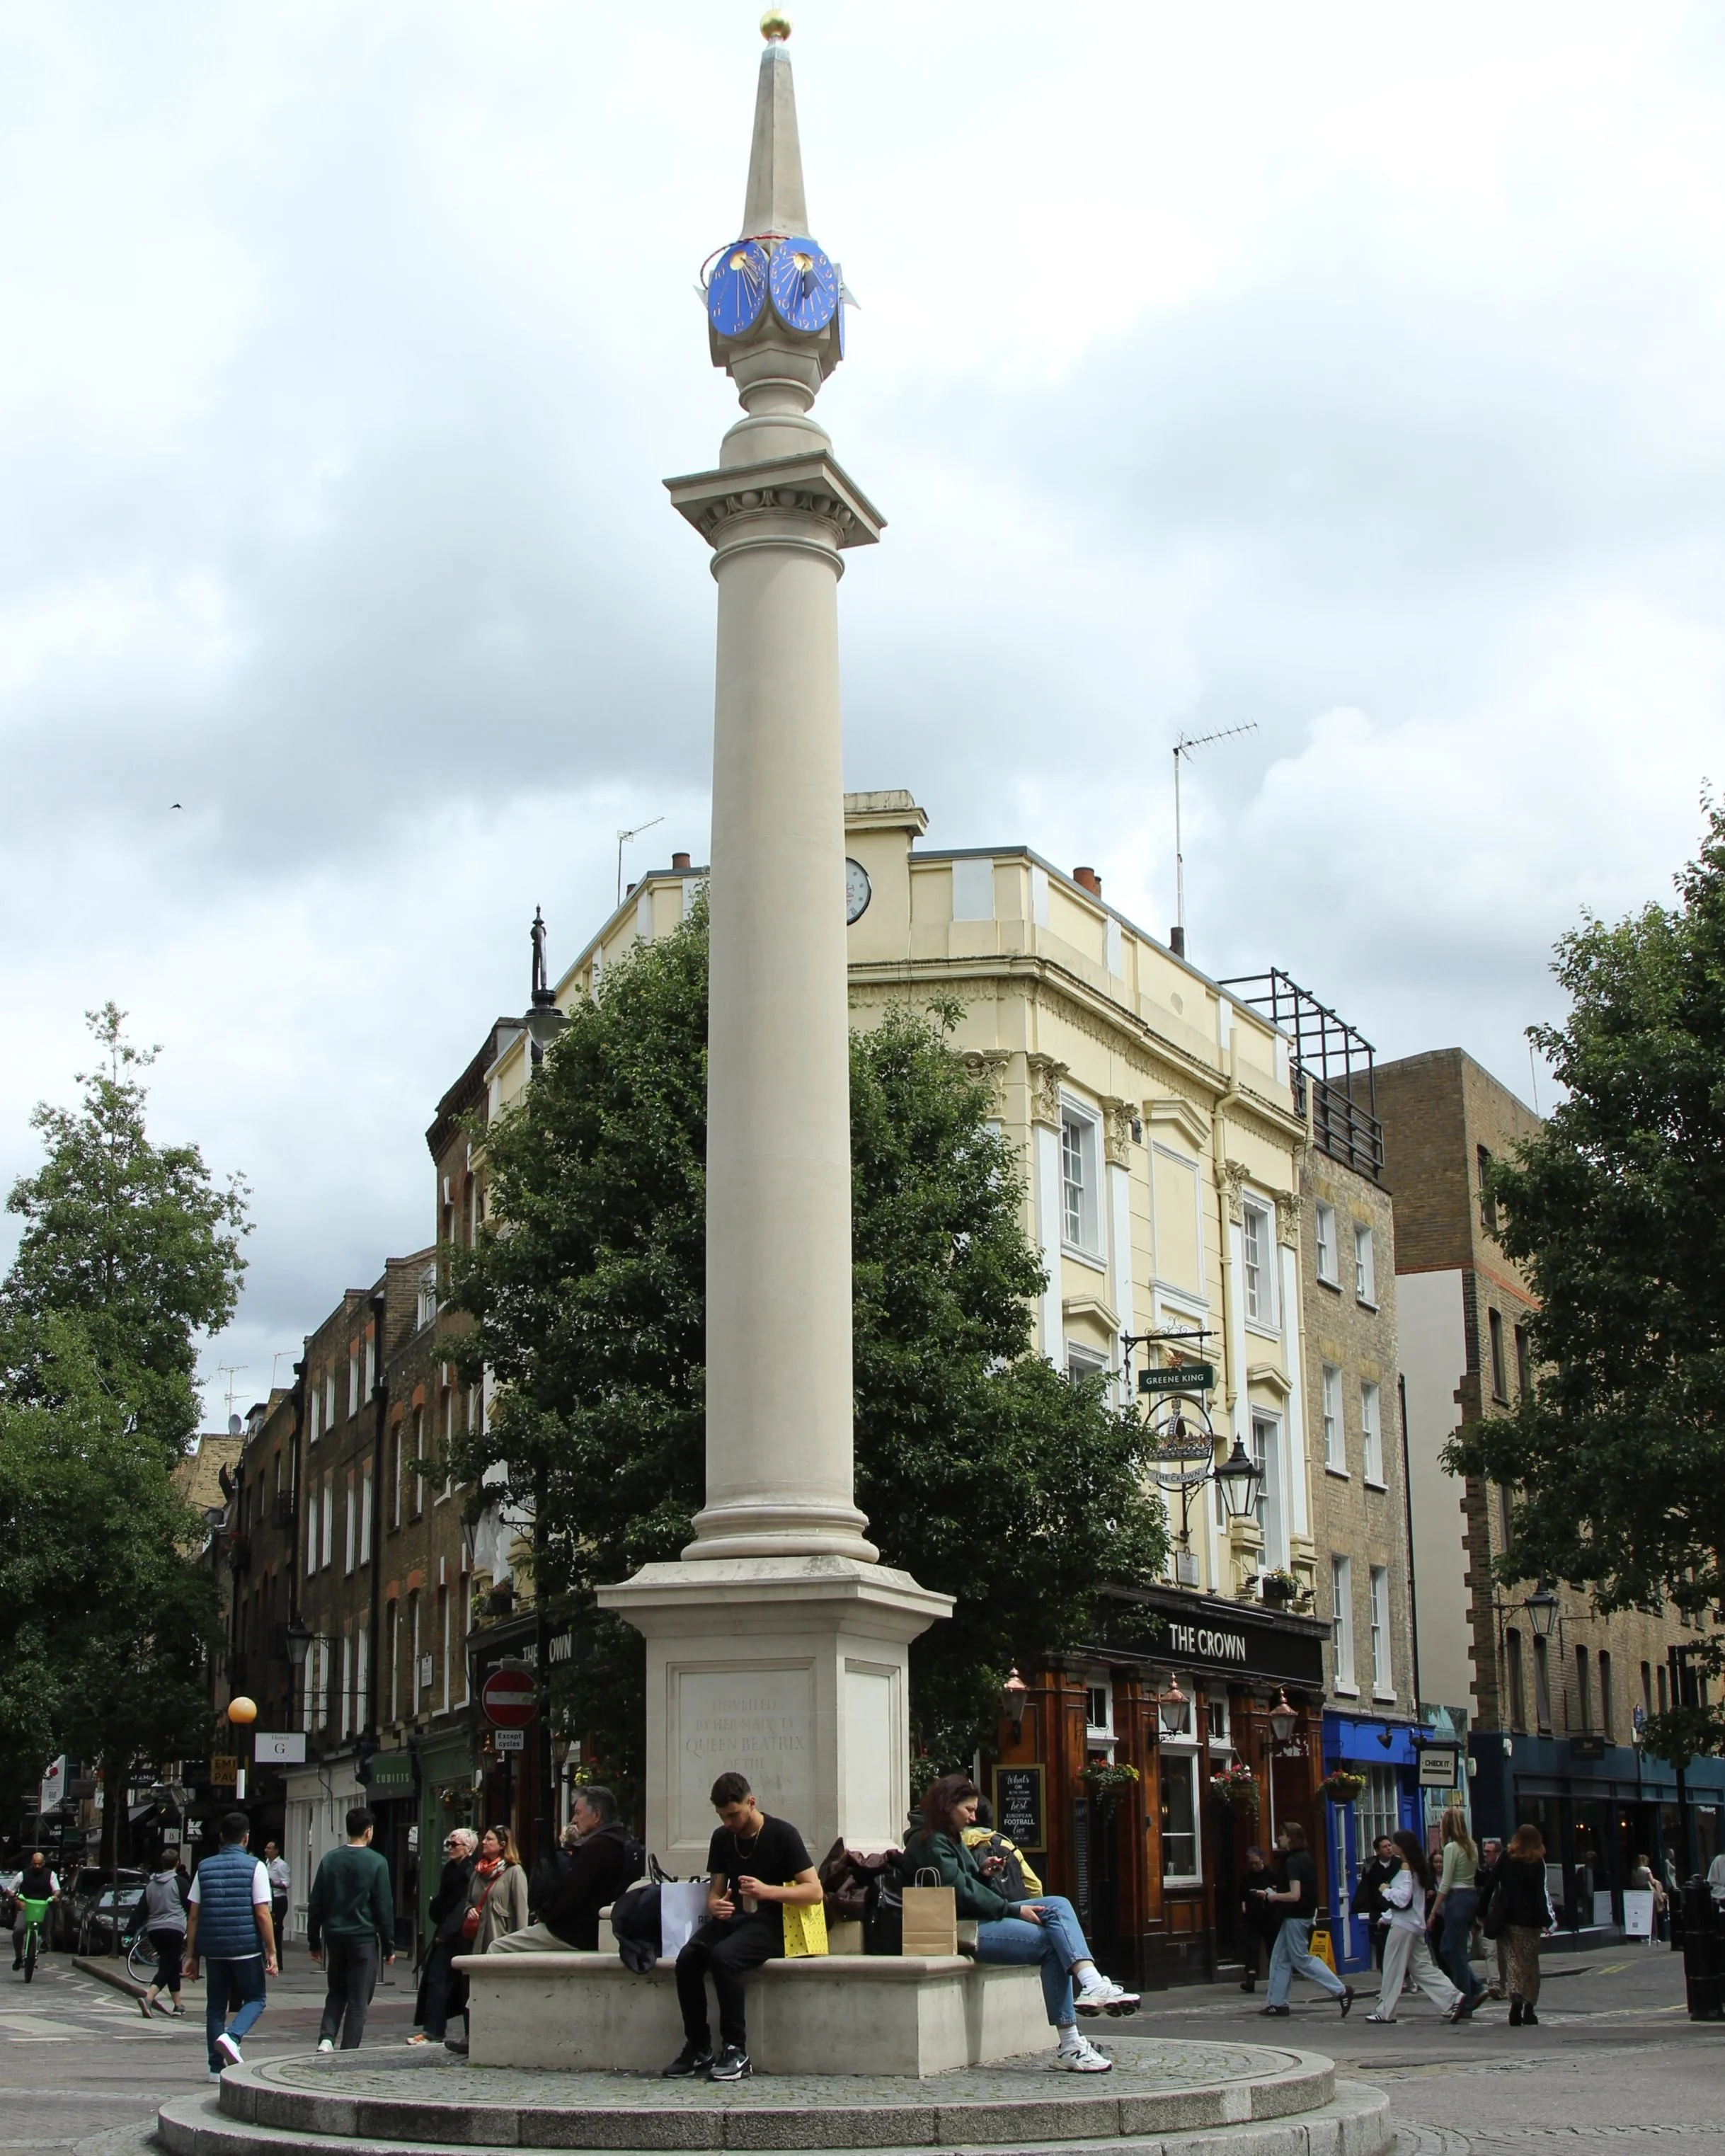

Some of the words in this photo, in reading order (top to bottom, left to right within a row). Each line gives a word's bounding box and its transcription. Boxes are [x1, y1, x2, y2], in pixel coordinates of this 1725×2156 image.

[778, 298, 789, 310] 10
[798, 318, 810, 329] 12
[1145, 1375, 1179, 1384] GREENE
[1182, 1374, 1204, 1382] KING
[1155, 1473, 1169, 1481] THE
[1171, 1471, 1200, 1481] CROWN
[1169, 1623, 1196, 1653] THE
[1198, 1629, 1246, 1661] CROWN
[275, 1743, 285, 1755] G
[686, 1737, 737, 1759] QUEEN
[743, 1736, 805, 1752] BEATRIX
[214, 1759, 236, 1768] EMI
[743, 1758, 766, 1770] THE
[214, 1772, 237, 1782] PAU
[376, 1772, 409, 1784] CUBITTS
[1010, 1801, 1028, 1811] best
